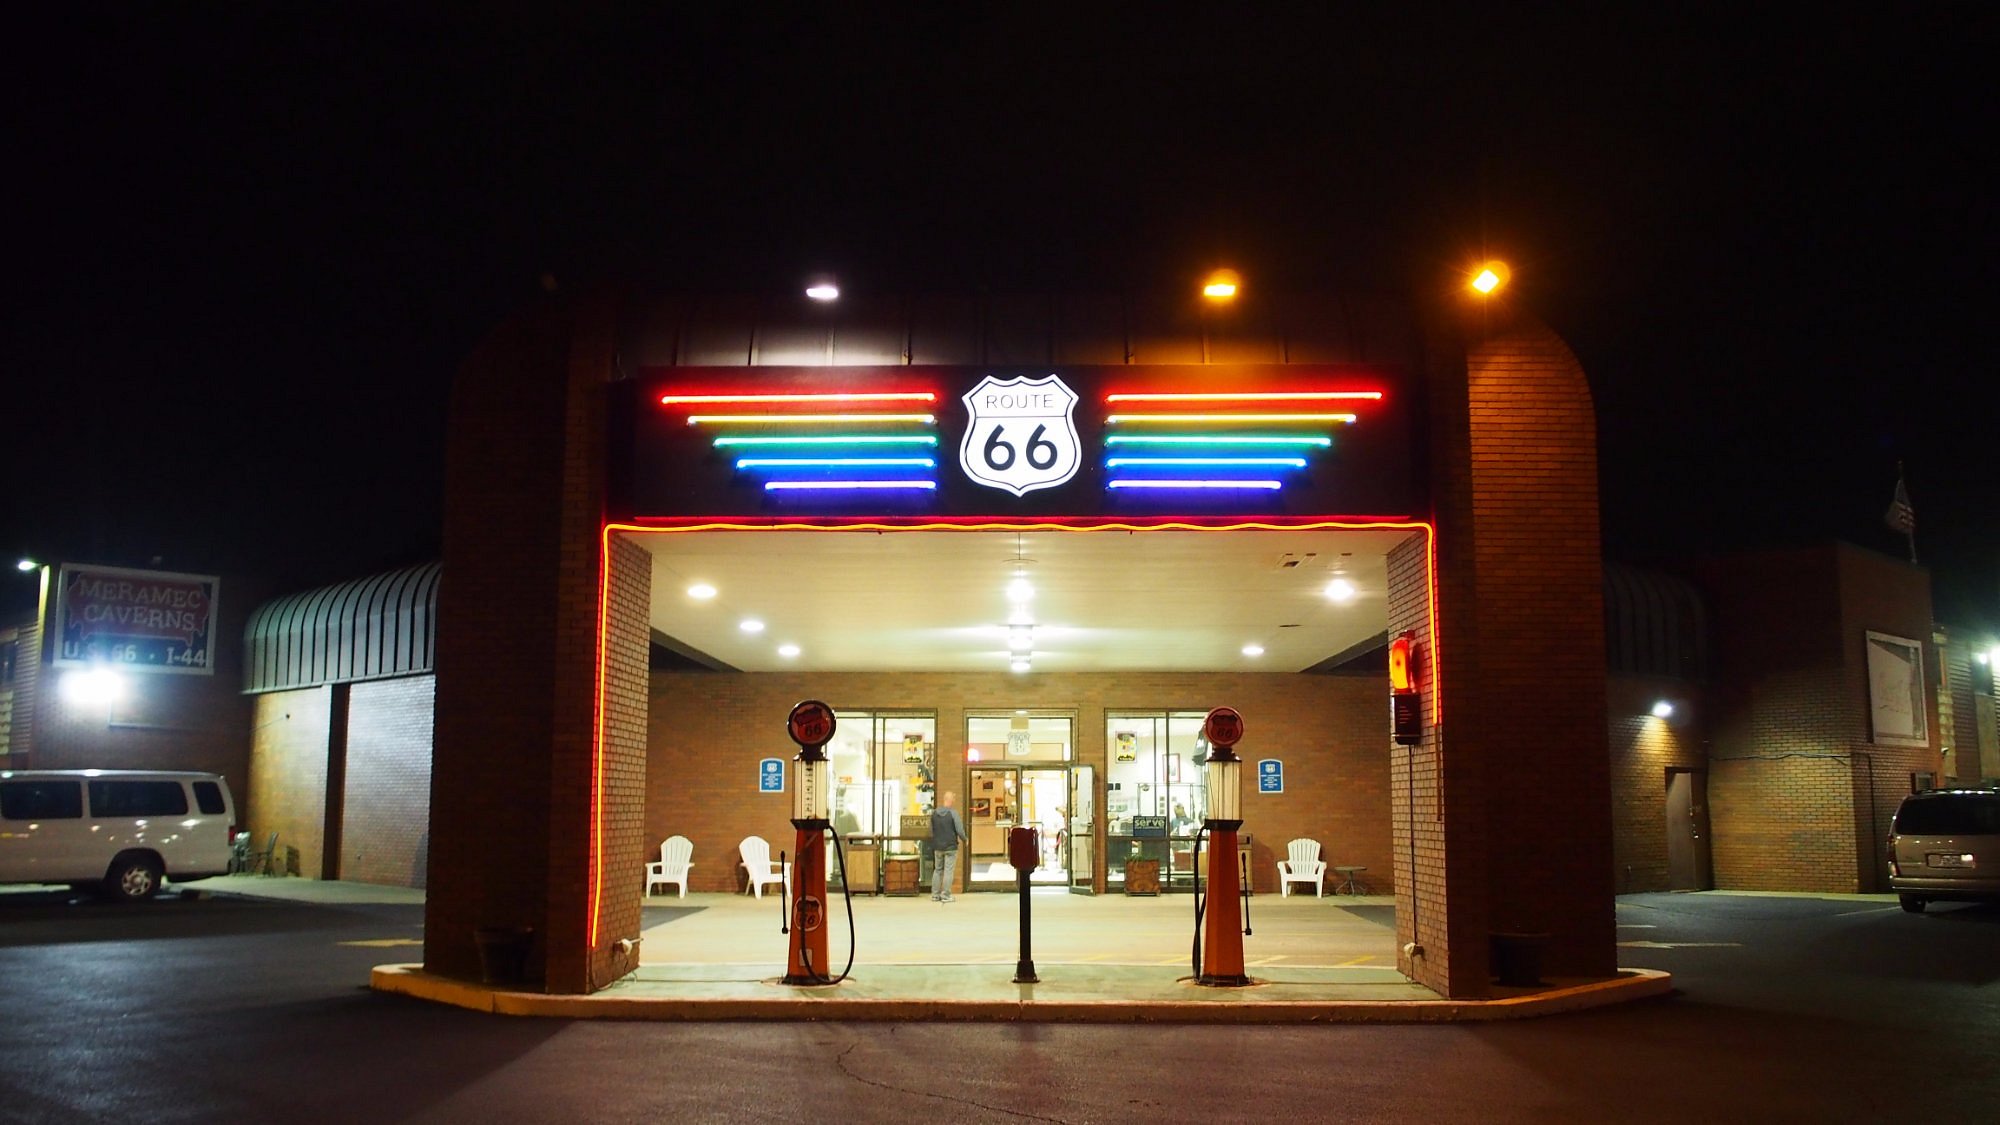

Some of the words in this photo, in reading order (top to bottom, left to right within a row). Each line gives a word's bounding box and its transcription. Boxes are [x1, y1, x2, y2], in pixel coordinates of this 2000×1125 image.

[986, 394, 1054, 409] ROUTE
[984, 424, 1058, 471] 66
[79, 578, 201, 609] MERAMEC
[83, 604, 196, 632] CAVERNS
[112, 643, 137, 662] 66
[166, 646, 206, 667] I-44
[1135, 819, 1165, 827] serve
